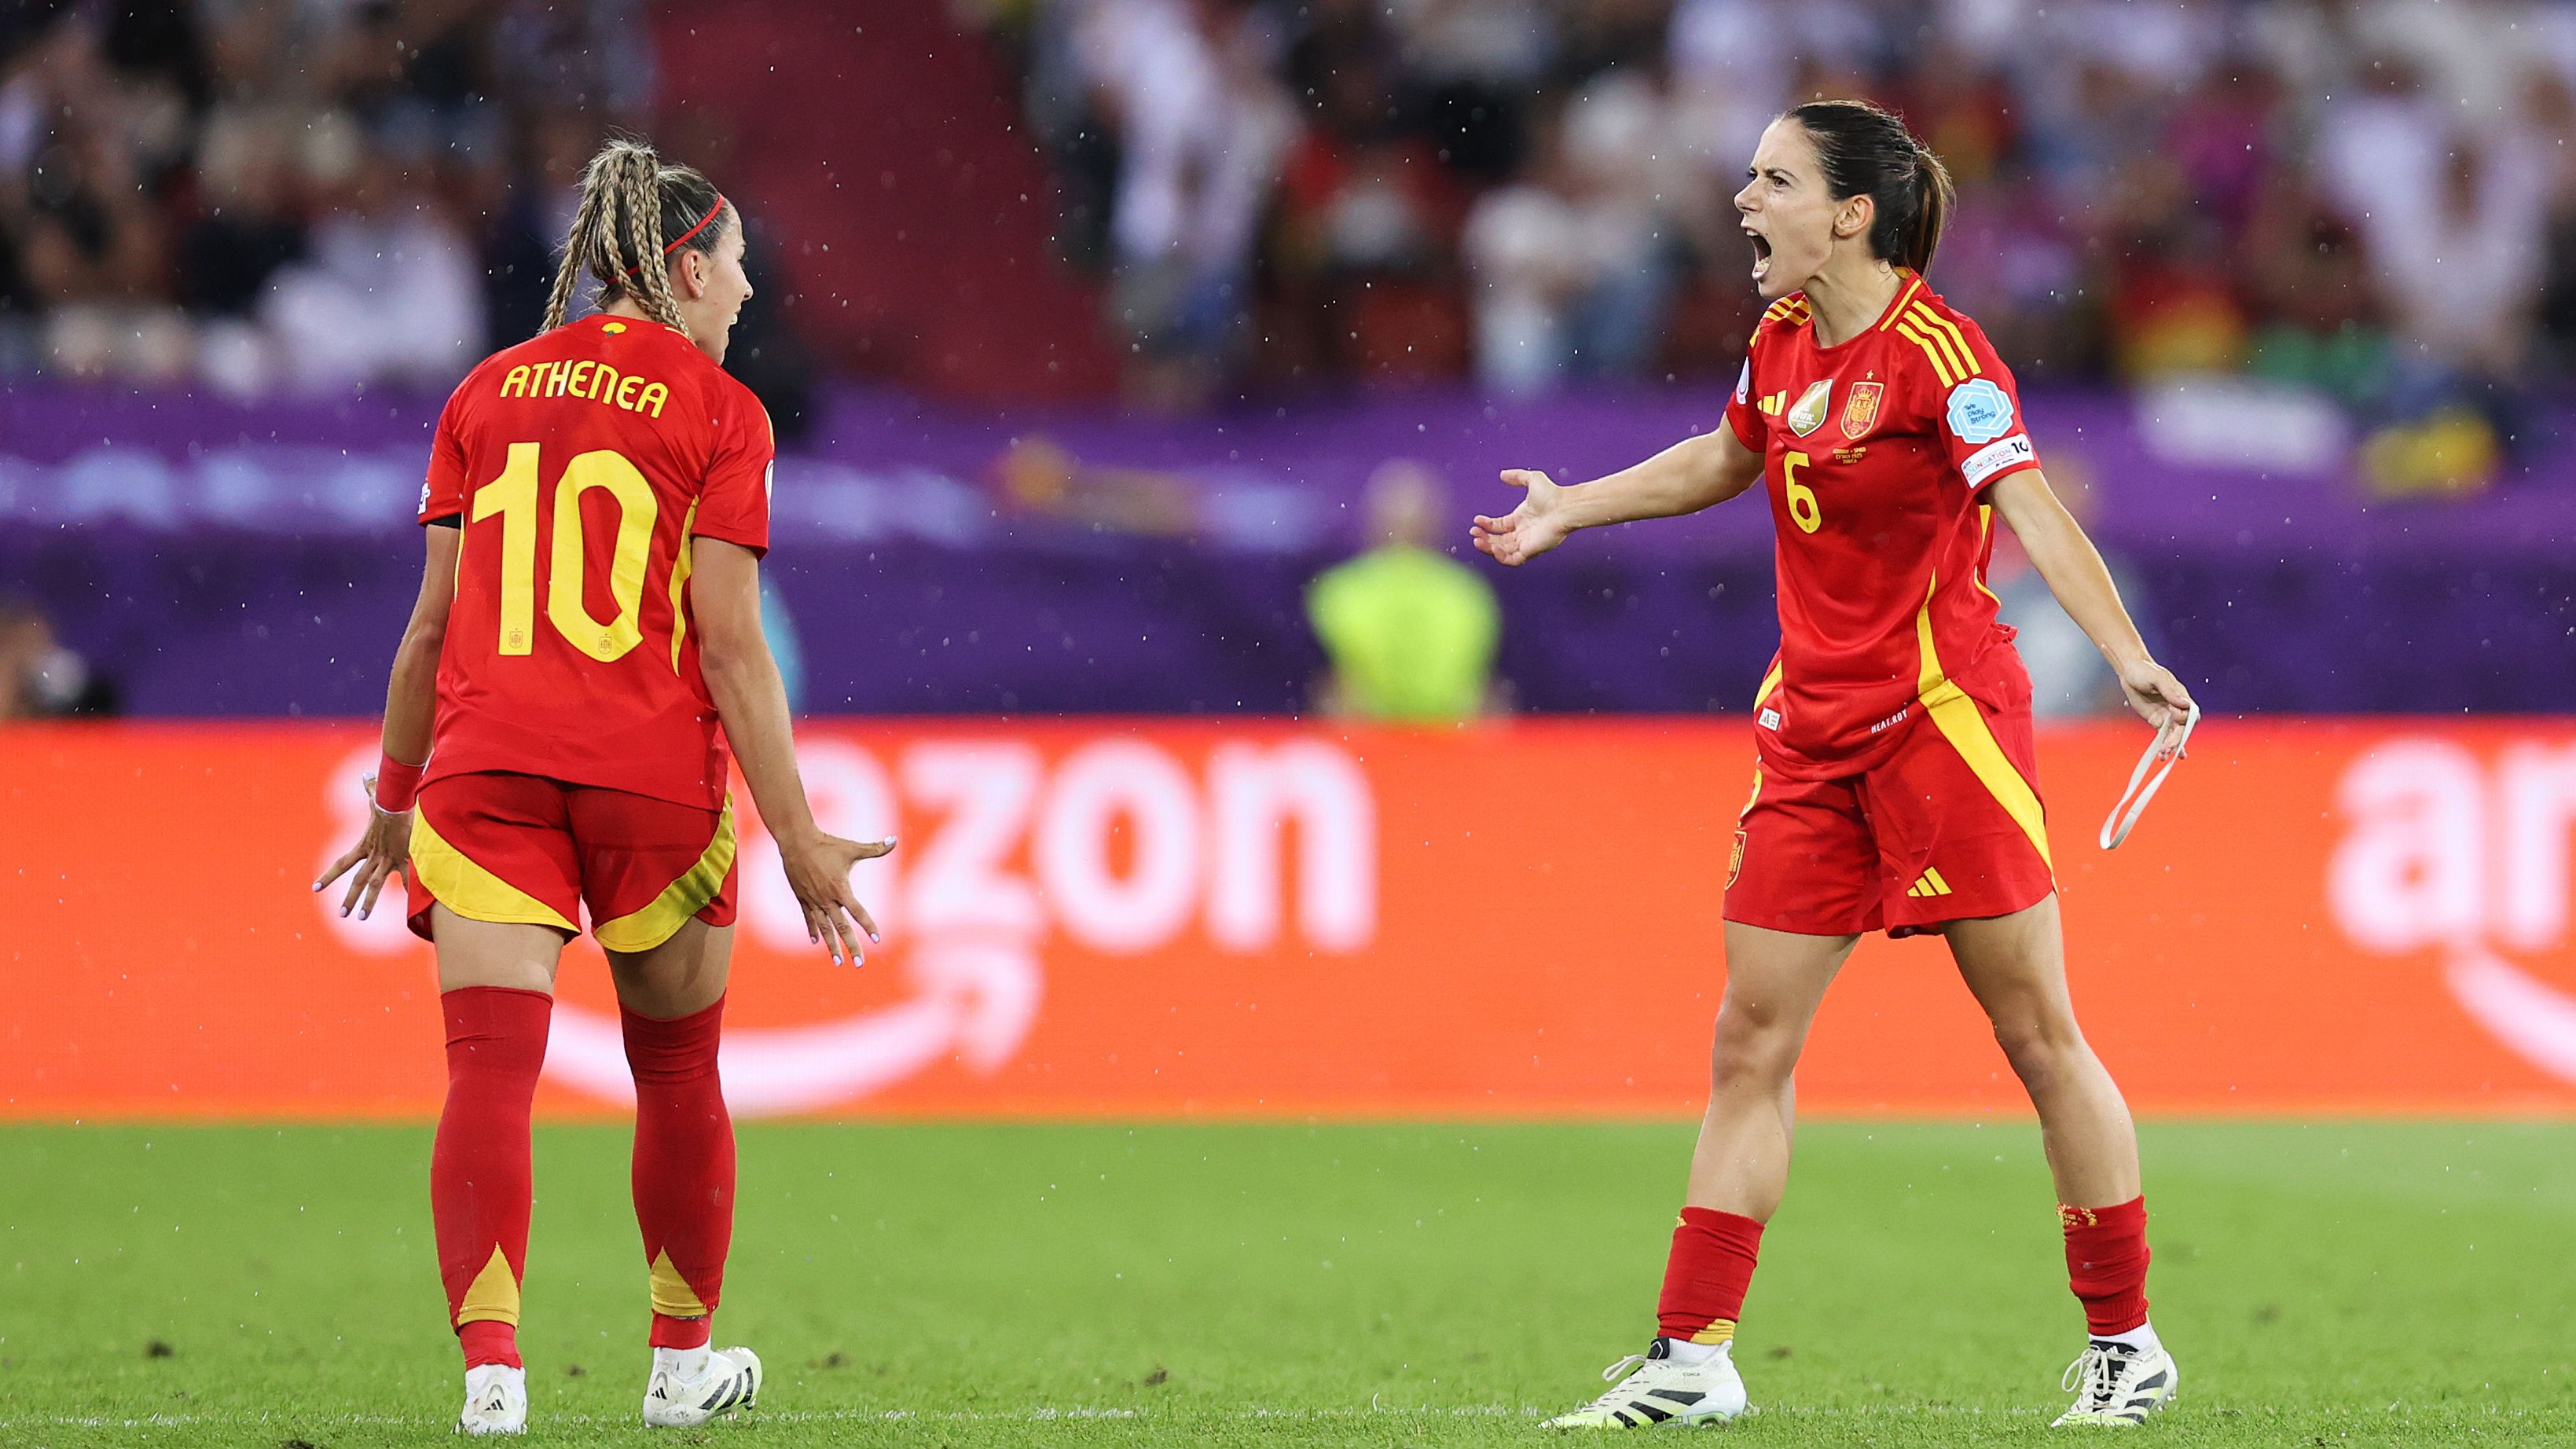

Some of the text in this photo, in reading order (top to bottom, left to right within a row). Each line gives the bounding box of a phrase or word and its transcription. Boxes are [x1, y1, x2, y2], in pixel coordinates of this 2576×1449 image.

[499, 359, 669, 419] ATHENEA
[1784, 450, 1822, 534] 6
[472, 442, 659, 662] 10
